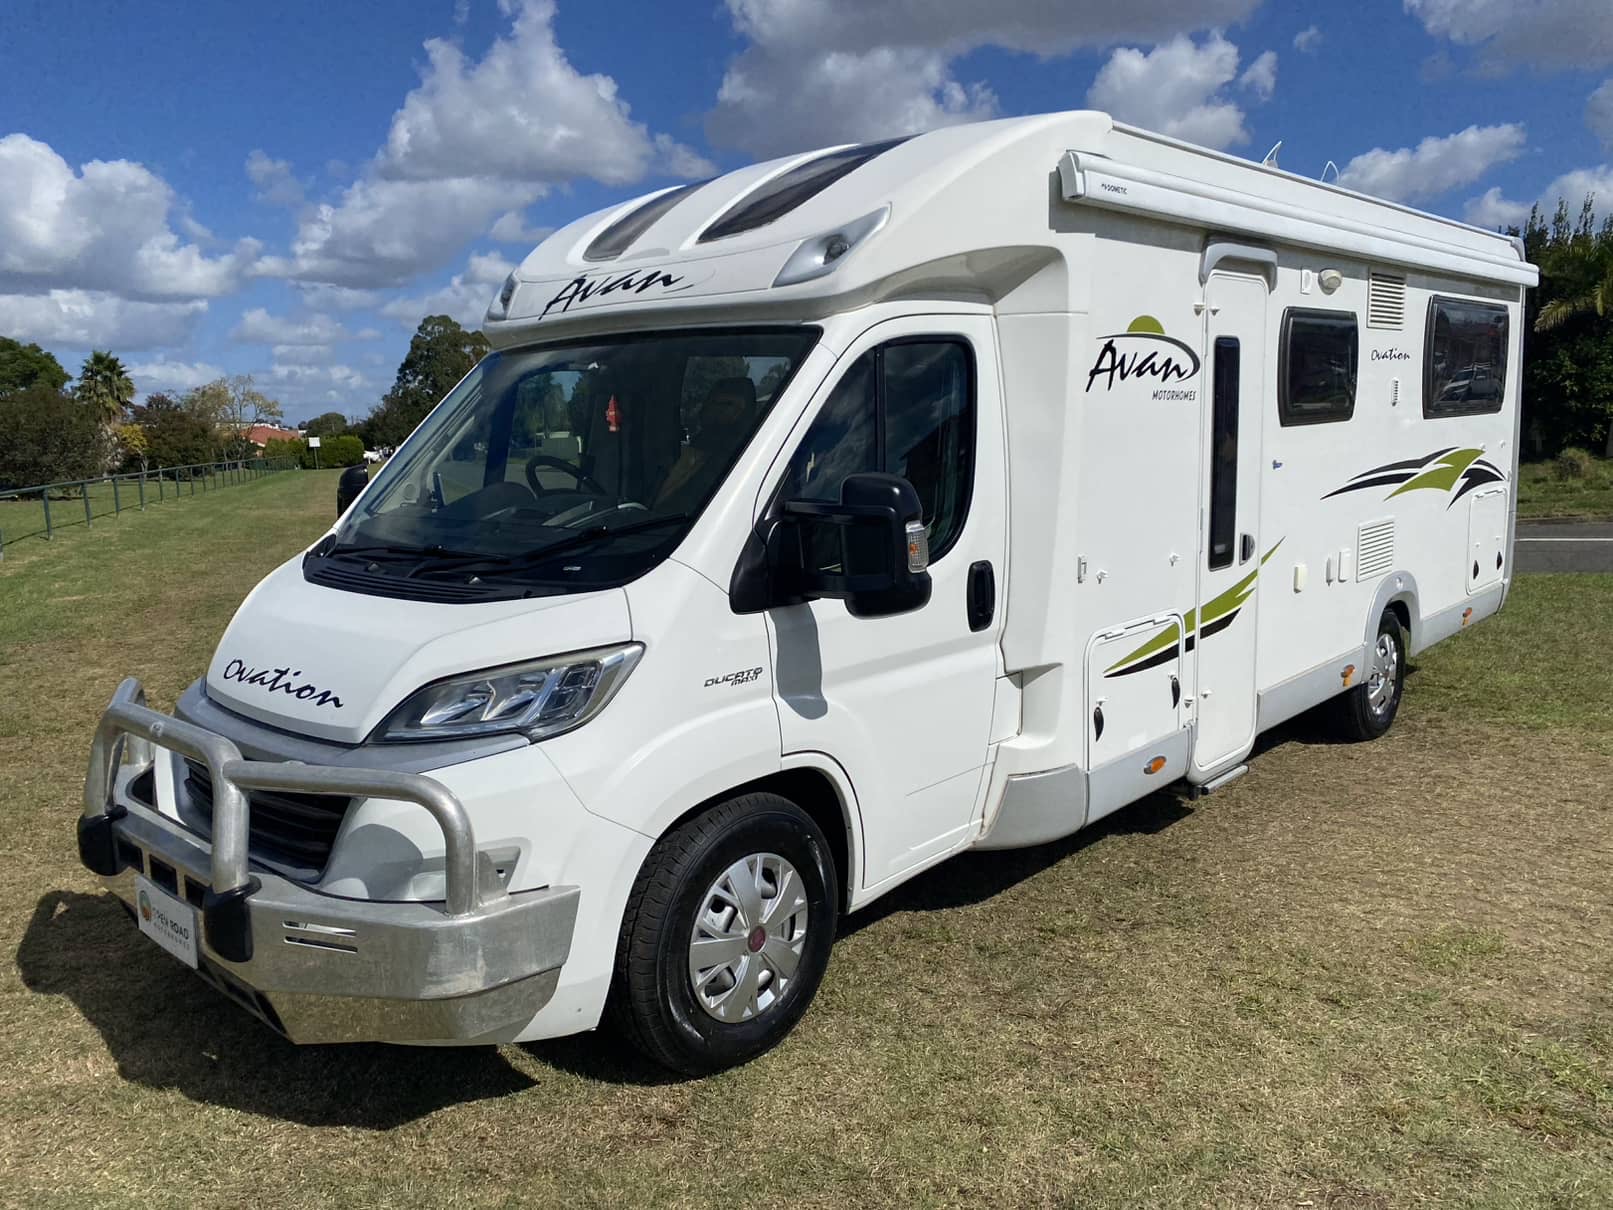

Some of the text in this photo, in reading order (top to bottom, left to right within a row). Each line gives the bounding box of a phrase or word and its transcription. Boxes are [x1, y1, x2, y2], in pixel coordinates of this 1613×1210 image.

[537, 269, 685, 321] Avan
[1370, 348, 1410, 361] Ovation
[1085, 338, 1190, 393] Avan
[1152, 389, 1197, 401] MOTORHOMES
[223, 659, 344, 708] Ovation
[703, 666, 763, 687] DUCATO
[169, 919, 190, 940] ROAD
